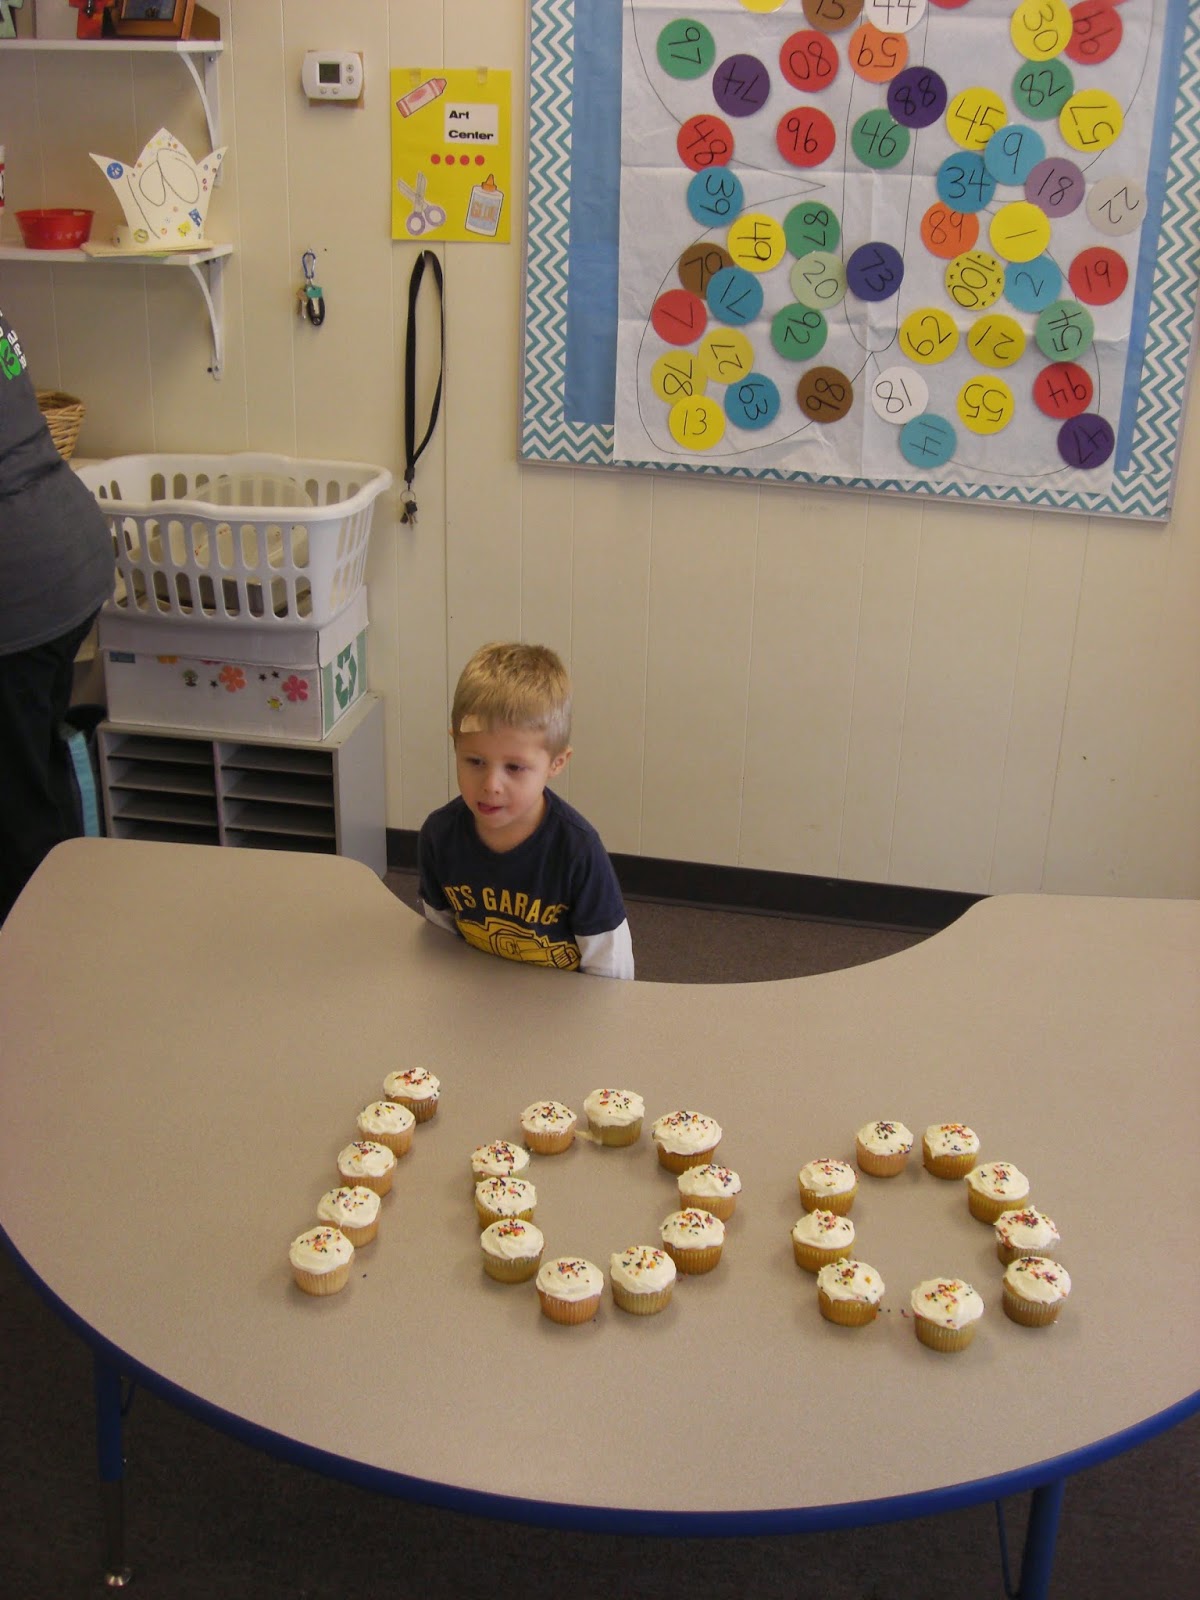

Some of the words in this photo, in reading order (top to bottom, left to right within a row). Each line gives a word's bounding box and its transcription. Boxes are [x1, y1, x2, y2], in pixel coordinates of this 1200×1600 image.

[668, 26, 702, 65] 97
[1023, 4, 1059, 52] 30
[789, 41, 832, 80] 80
[857, 34, 900, 69] 59
[722, 63, 759, 103] 74
[894, 75, 937, 116] 88
[1020, 70, 1065, 107] 82
[449, 110, 470, 120] Art
[955, 98, 1005, 144] 45
[1069, 105, 1115, 145] 57
[448, 129, 494, 140] Center
[686, 119, 728, 166] 48
[787, 117, 819, 154] 96
[860, 118, 898, 158] 46
[1003, 132, 1024, 175] 9
[699, 174, 736, 216] 39
[945, 166, 991, 202] 34
[1037, 168, 1074, 206] 18
[1098, 186, 1140, 224] 22
[737, 221, 772, 261] 49
[803, 210, 829, 247] 87
[928, 210, 964, 244] 89
[802, 259, 839, 299] 20
[860, 249, 894, 293] 73
[951, 257, 995, 308] 100
[1014, 271, 1045, 297] 2
[1085, 260, 1112, 293] 19
[661, 302, 695, 329] 7
[784, 311, 822, 345] 92
[1047, 308, 1084, 352] 54
[906, 315, 953, 357] 62
[662, 359, 694, 397] 78
[710, 343, 744, 375] 27
[737, 383, 769, 421] 63
[875, 378, 913, 414] 81
[963, 383, 1008, 423] 55
[1047, 370, 1088, 409] 94
[683, 408, 708, 436] 13
[908, 421, 948, 457] 14
[482, 887, 570, 926] GARAGE
